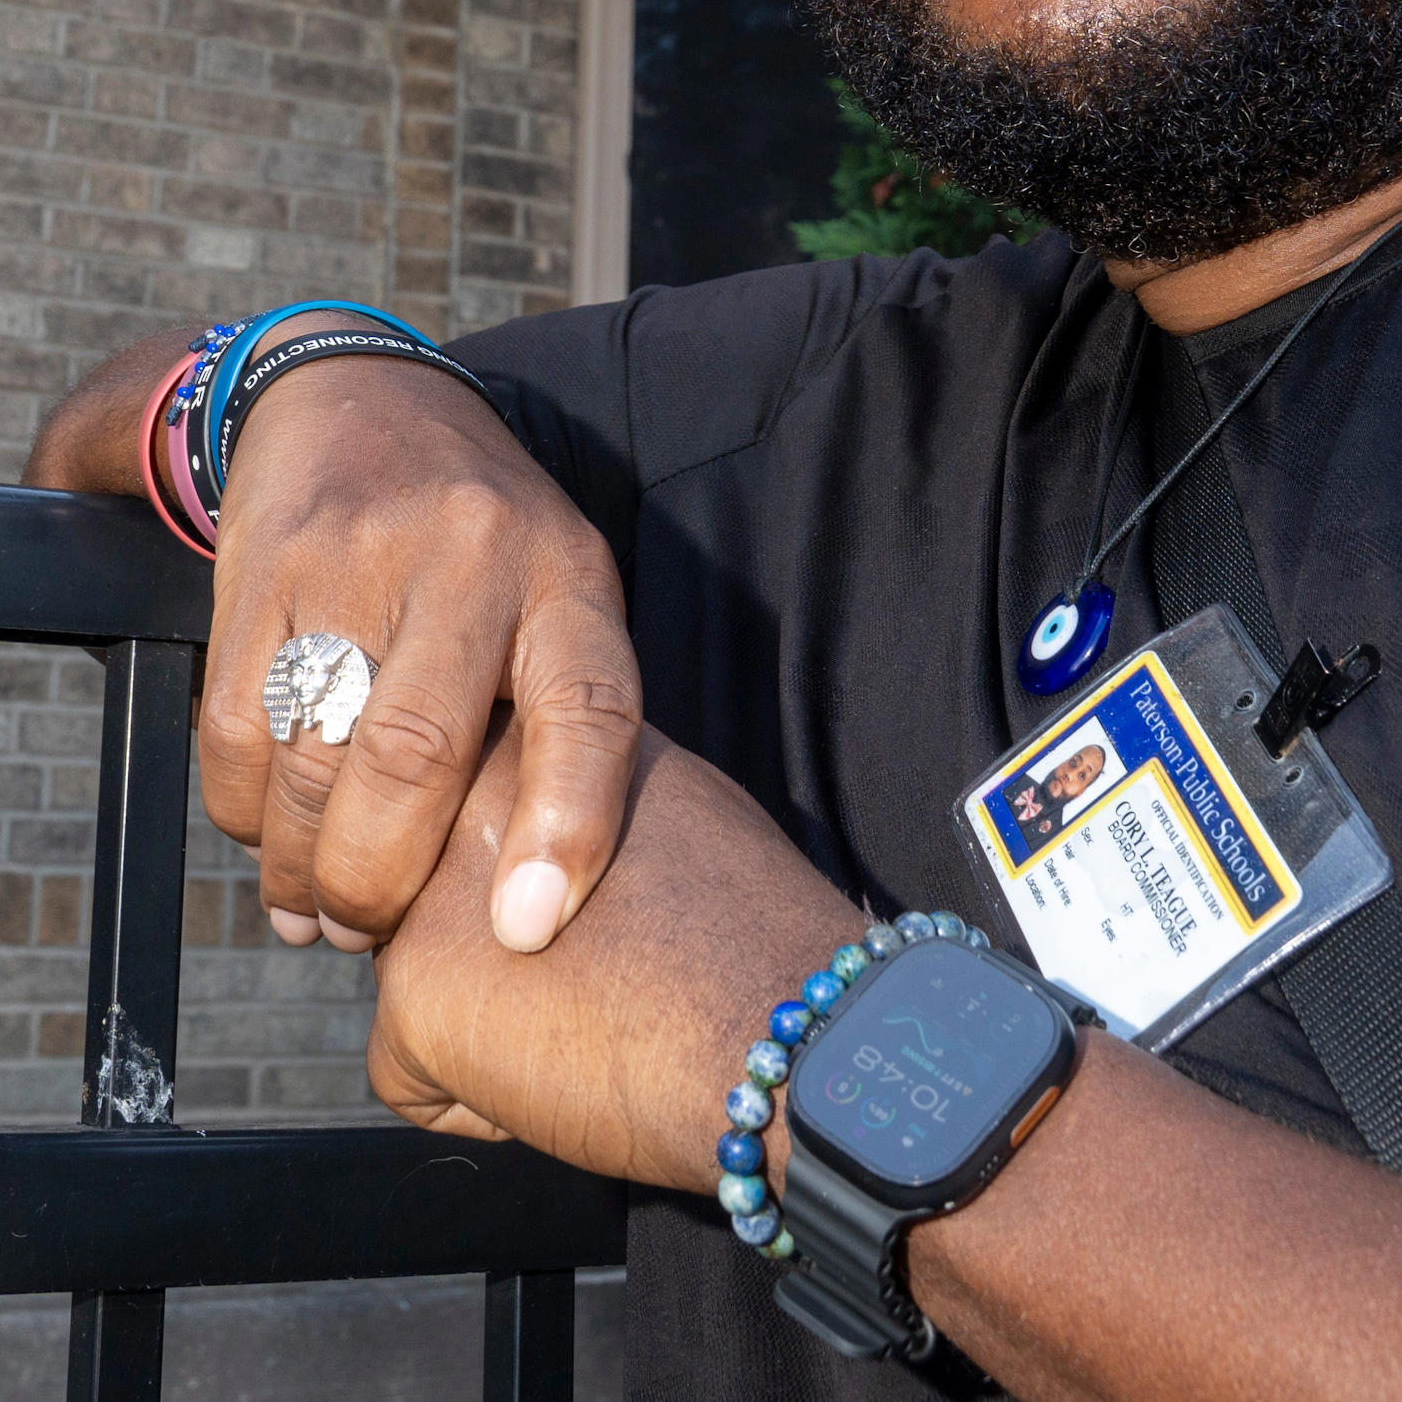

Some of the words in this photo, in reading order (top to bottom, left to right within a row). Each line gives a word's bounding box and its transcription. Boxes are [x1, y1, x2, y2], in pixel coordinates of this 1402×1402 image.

[243, 334, 414, 391] RECONNECTING
[1129, 679, 1183, 764] Paterson
[1175, 756, 1220, 826] Public
[1210, 818, 1266, 902] Schools
[1044, 857, 1058, 879] Date
[1054, 878, 1066, 889] of
[1107, 820, 1136, 863] BOARD
[1130, 862, 1187, 957] COMMISSIONER
[1115, 801, 1150, 847] CORY
[1140, 846, 1155, 867] L.
[1151, 863, 1198, 938] TEAGUE
[1151, 799, 1180, 843] OFFICIAL
[1174, 840, 1225, 921] IDENTIFICATION
[853, 1044, 950, 1124] 10:48
